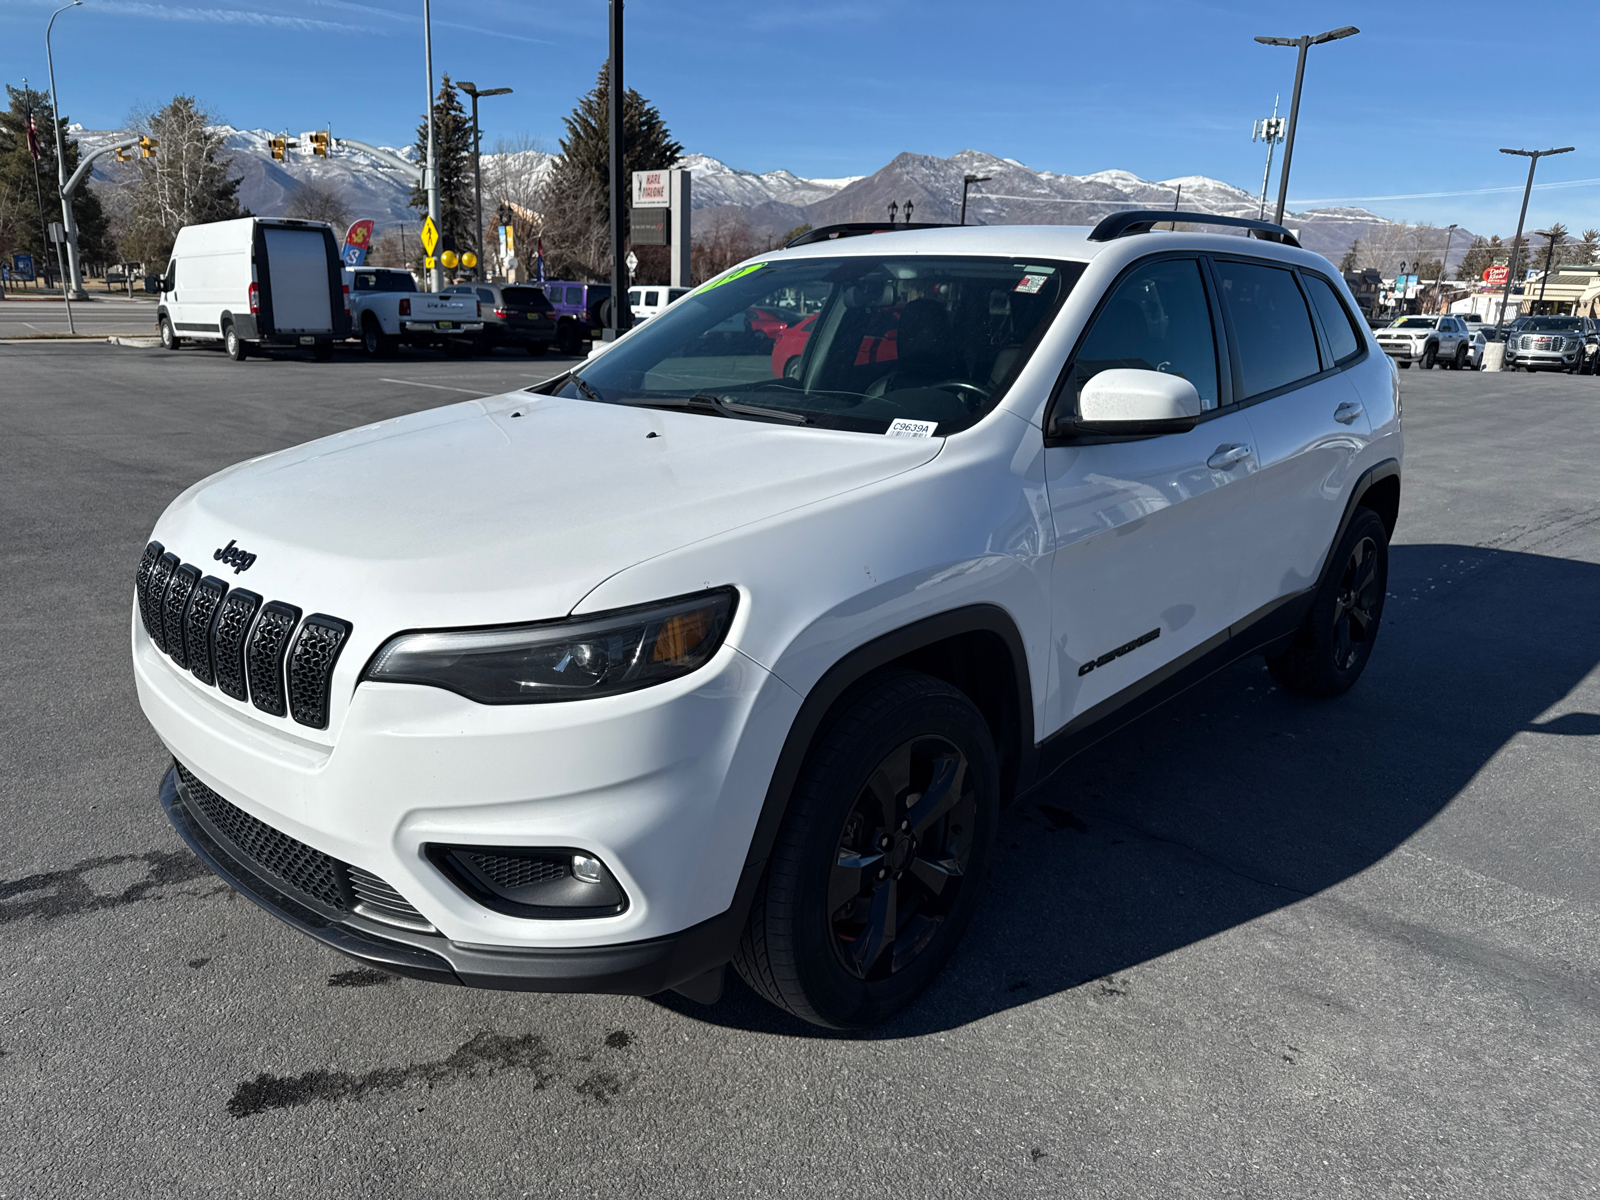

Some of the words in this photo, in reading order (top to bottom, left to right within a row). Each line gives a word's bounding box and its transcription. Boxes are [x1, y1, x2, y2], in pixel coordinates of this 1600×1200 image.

[893, 422, 929, 432] C9639A
[213, 539, 257, 575] Jeep
[1078, 627, 1161, 677] CHEROKEE
